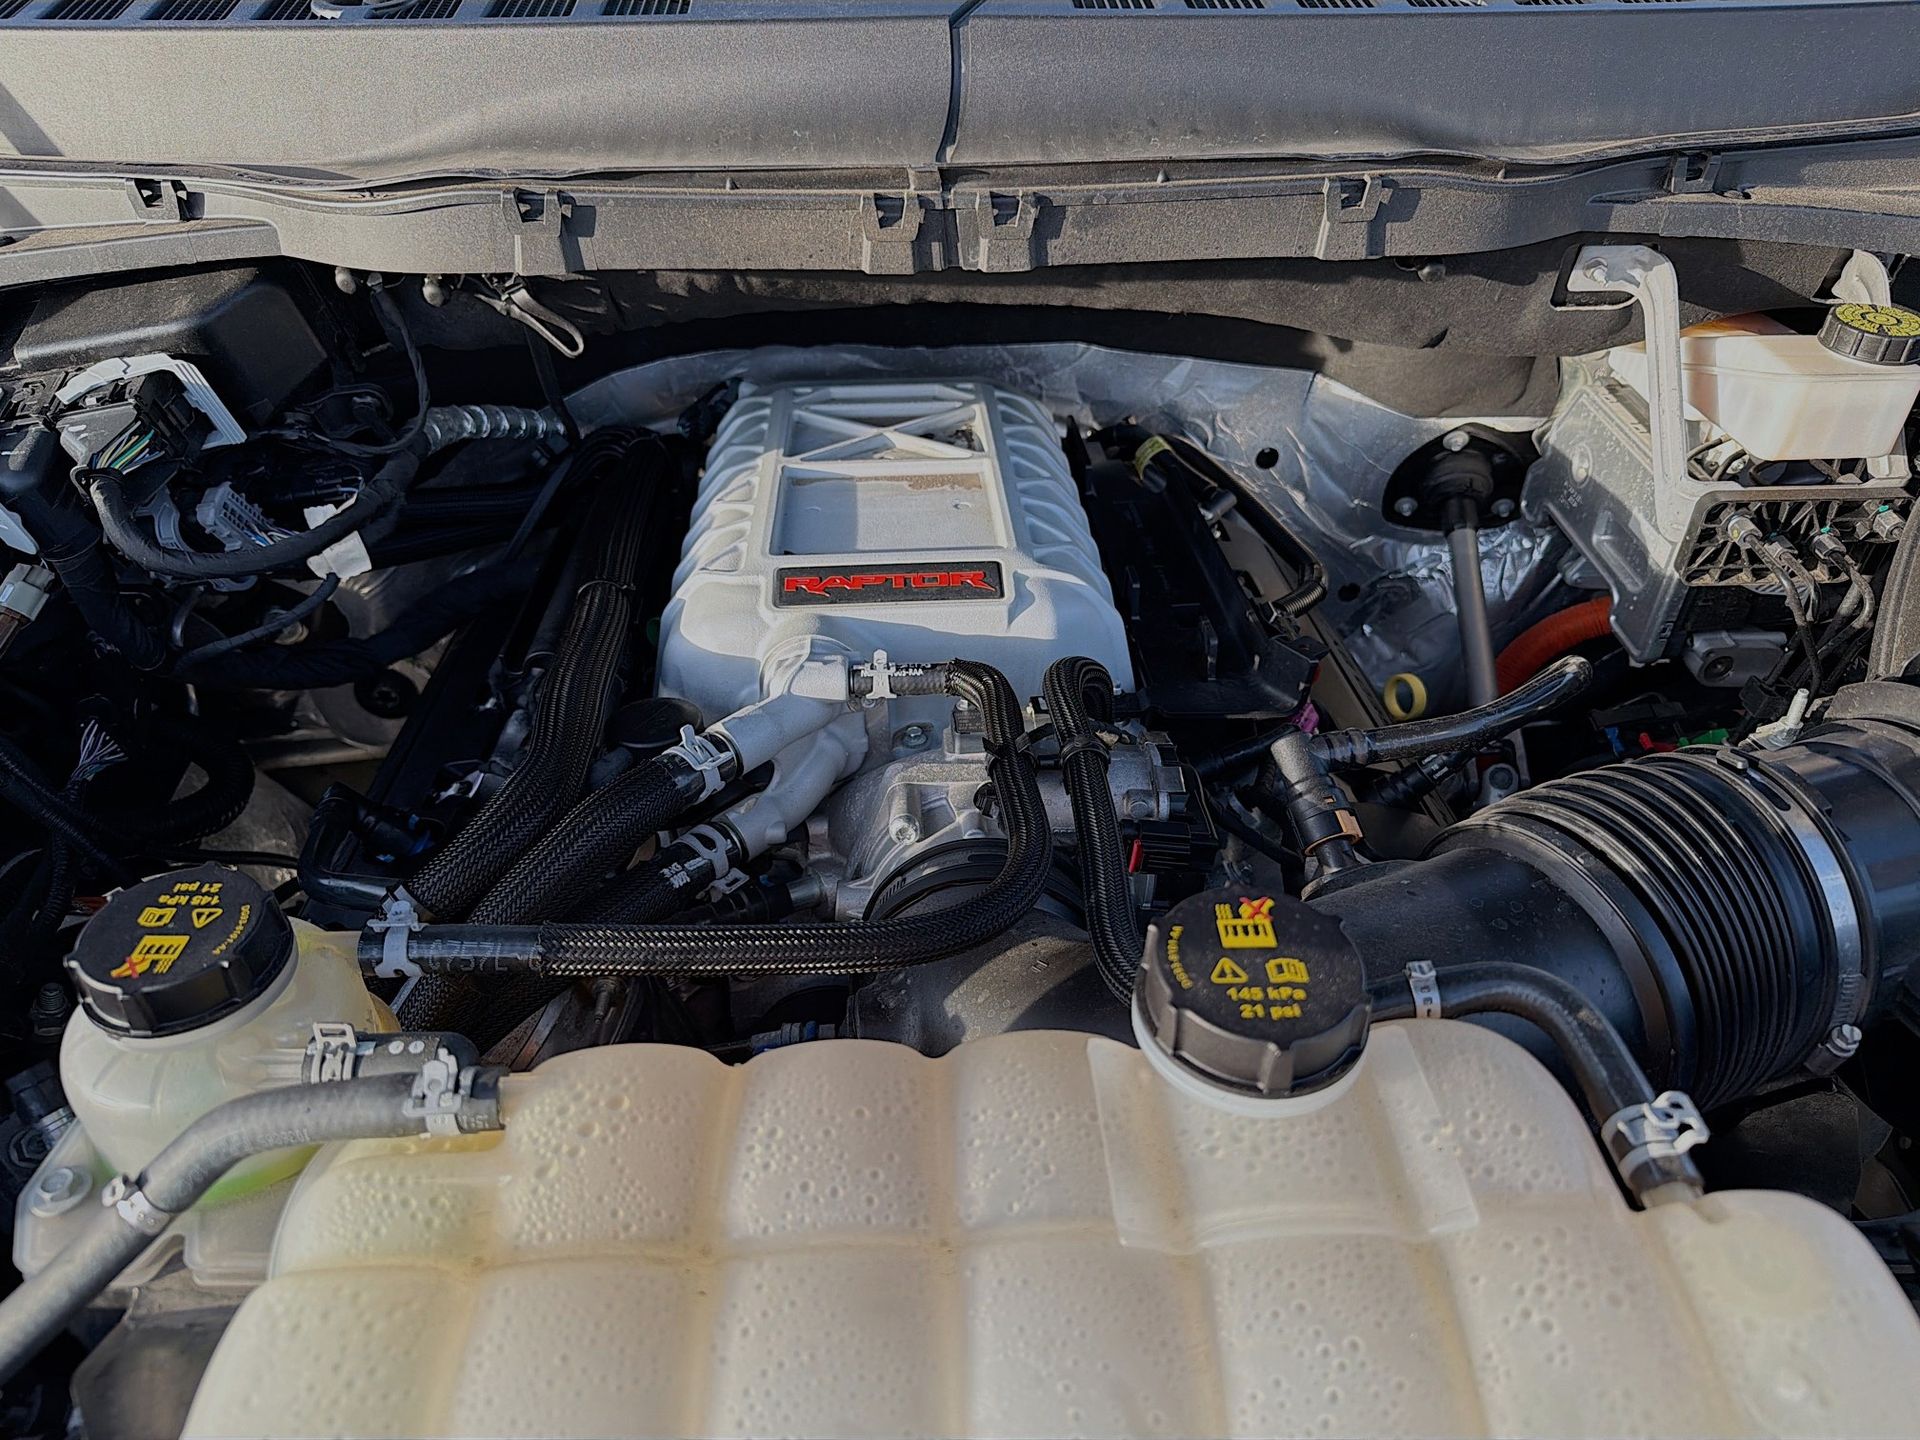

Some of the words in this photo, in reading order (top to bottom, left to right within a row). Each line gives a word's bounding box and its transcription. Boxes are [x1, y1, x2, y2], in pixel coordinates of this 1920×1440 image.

[784, 570, 997, 598] RAPTOR
[173, 881, 200, 893] psi
[202, 883, 223, 893] 21
[158, 895, 189, 905] kPa
[191, 895, 220, 905] 145
[1226, 987, 1264, 1001] 145
[1266, 986, 1307, 1001] kPa
[1239, 1004, 1265, 1019] 21
[1270, 1003, 1302, 1020] psi
